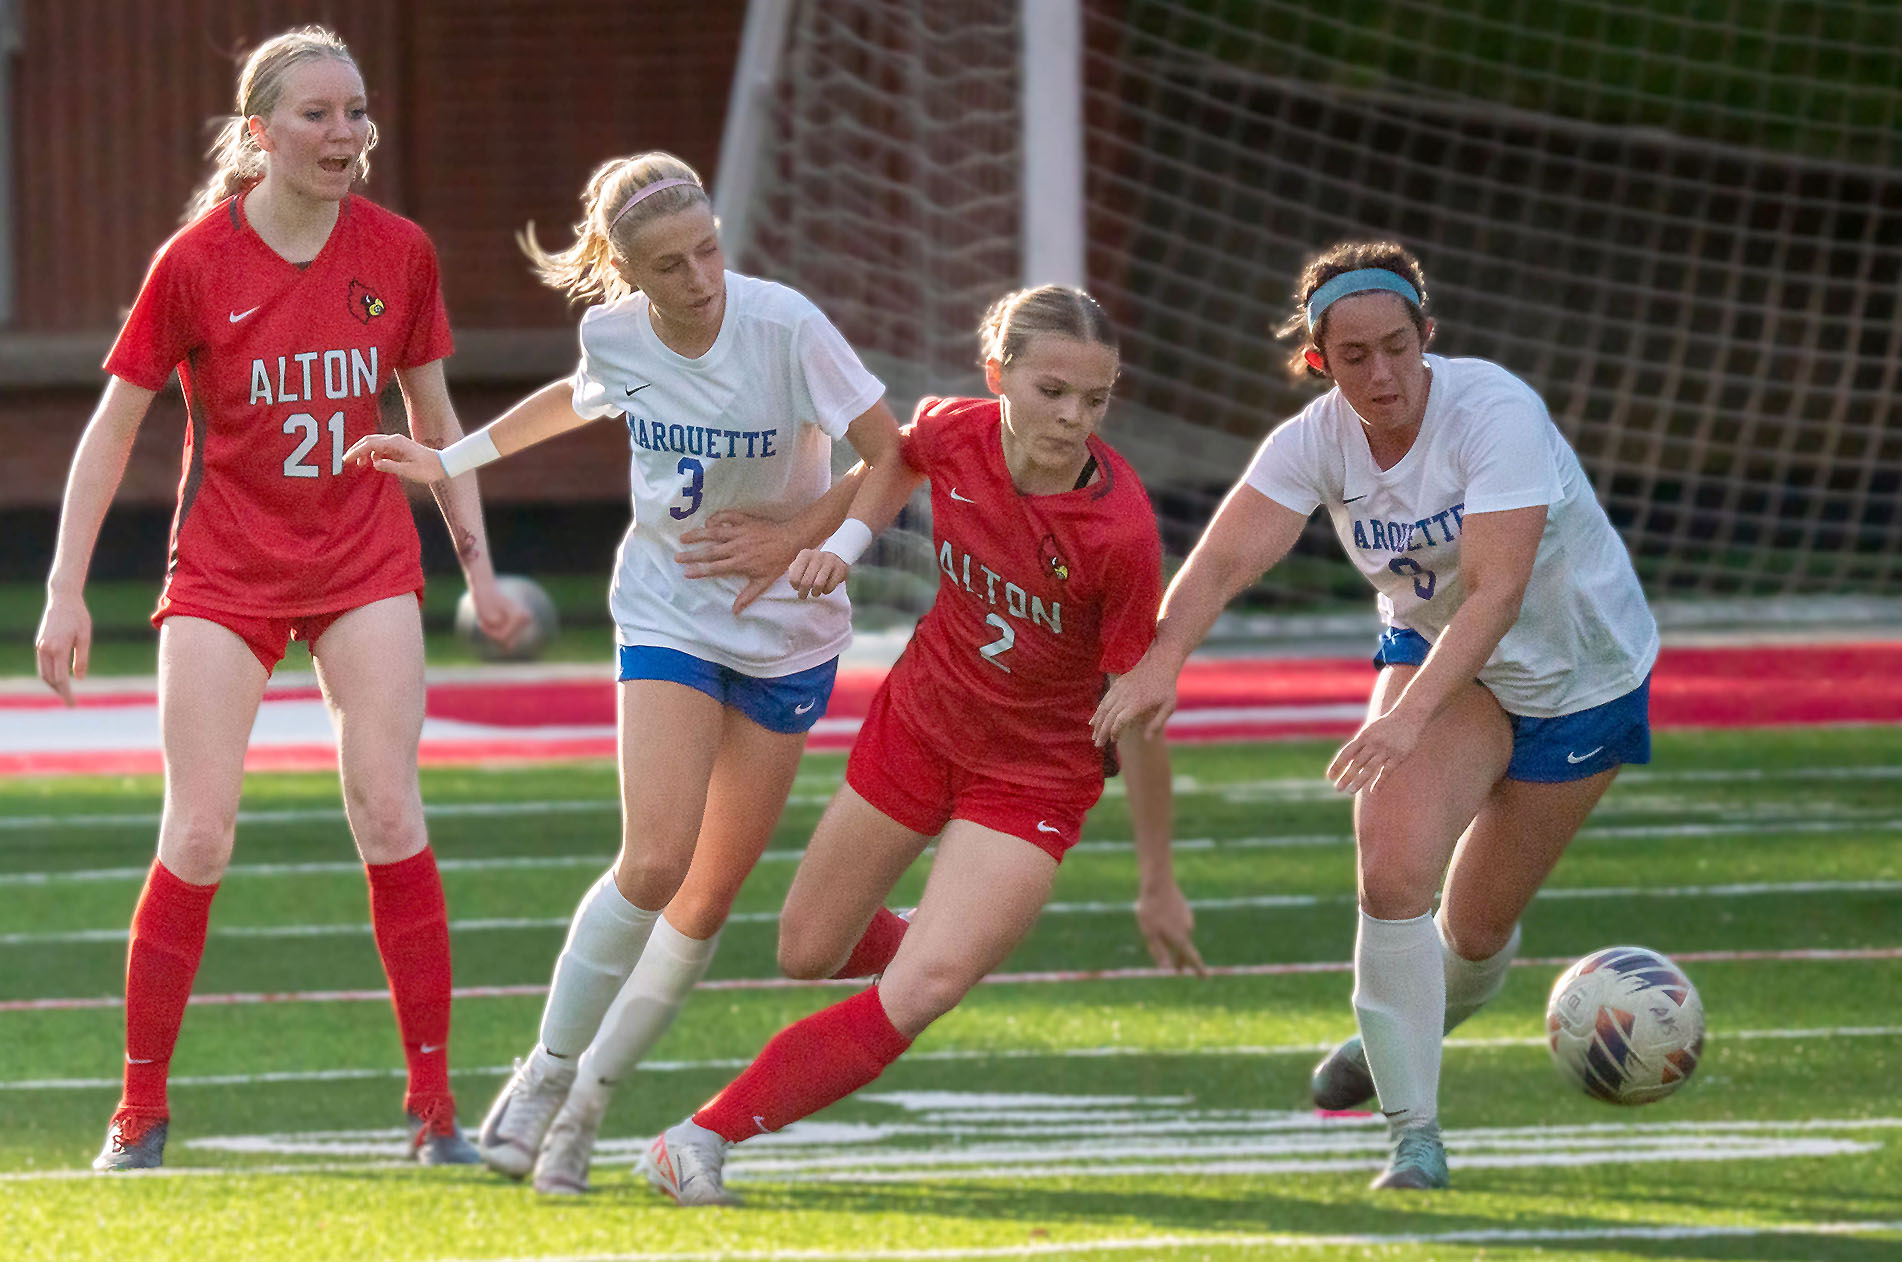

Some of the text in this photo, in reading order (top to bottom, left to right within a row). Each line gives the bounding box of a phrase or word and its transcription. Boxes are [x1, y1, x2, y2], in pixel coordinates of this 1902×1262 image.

[250, 346, 378, 405] ALTON
[283, 411, 345, 477] 21
[669, 456, 704, 520] 3
[1354, 502, 1465, 553] ARQUETTE
[940, 540, 1063, 634] ALTON
[979, 612, 1015, 674] 2
